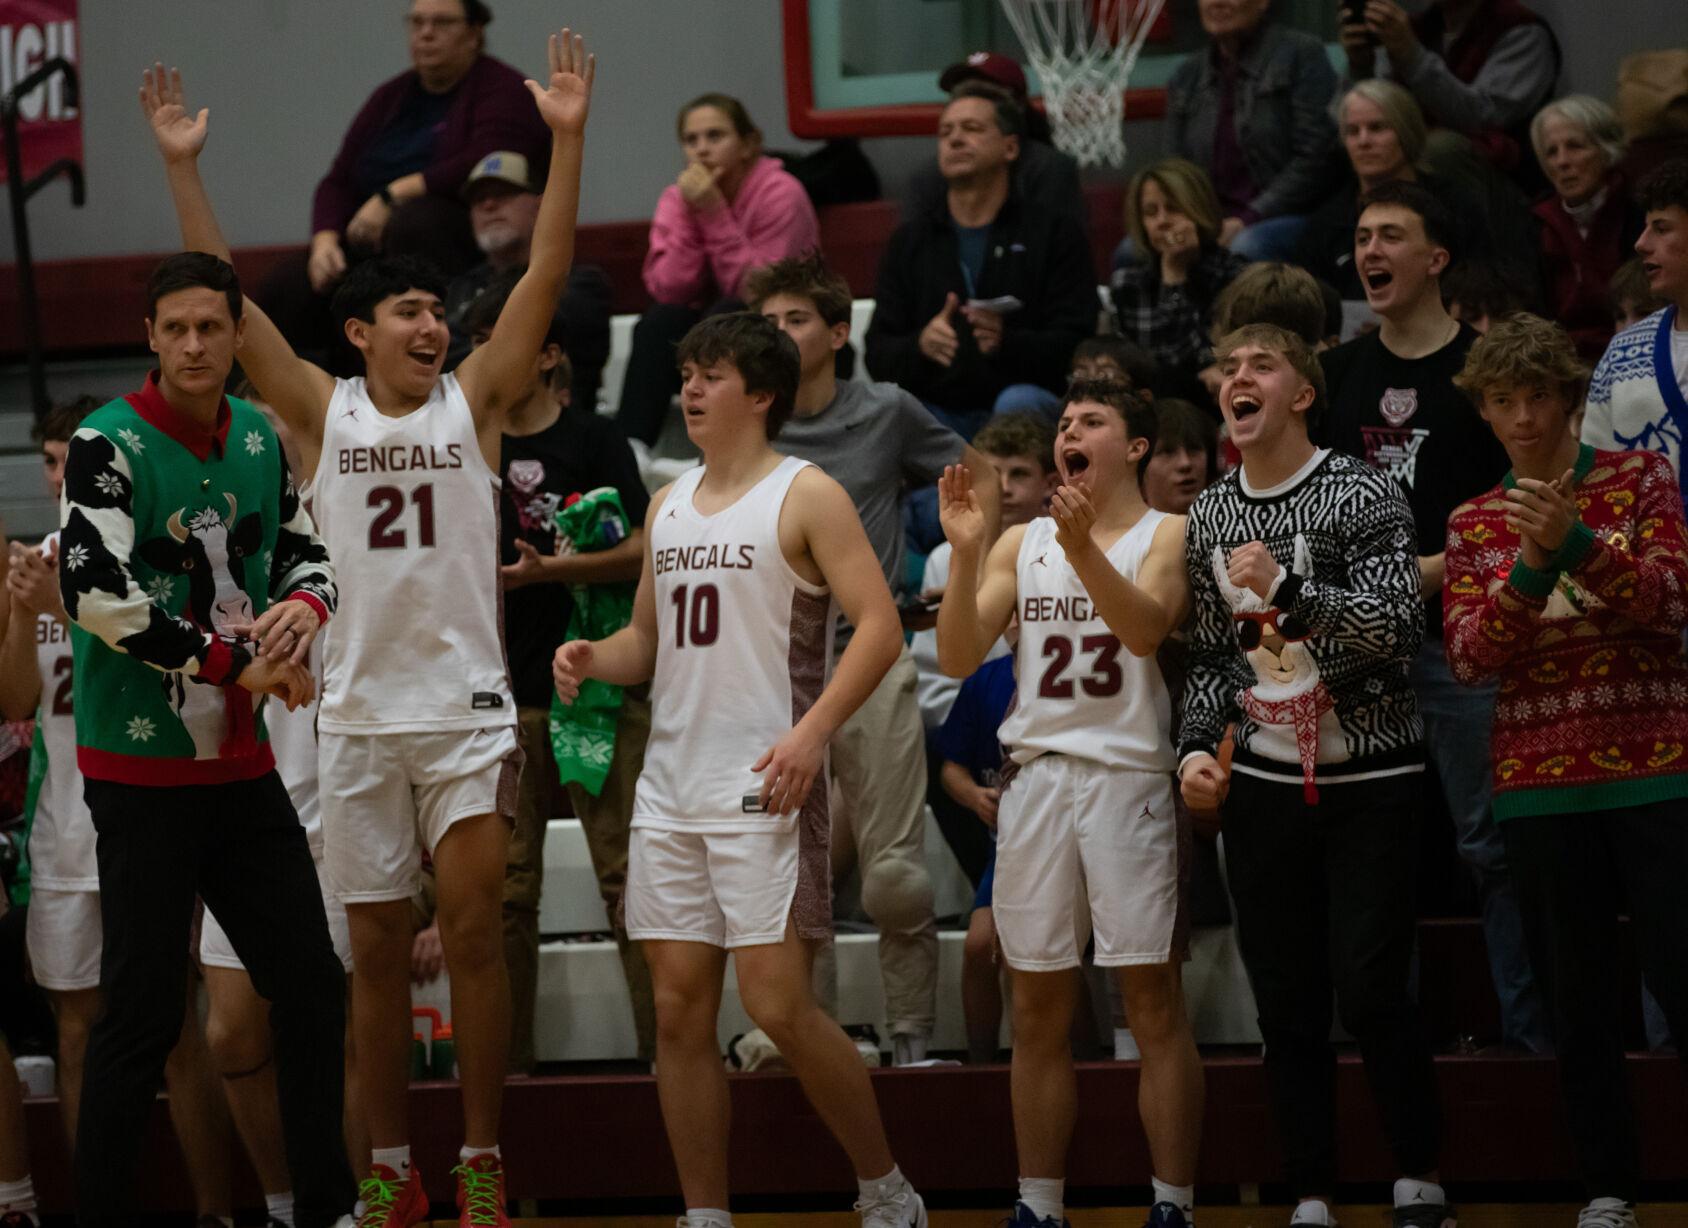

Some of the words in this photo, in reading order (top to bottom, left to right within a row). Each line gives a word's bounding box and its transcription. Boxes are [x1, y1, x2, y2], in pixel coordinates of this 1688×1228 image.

[339, 443, 462, 474] BENGALS
[366, 482, 436, 550] 21
[656, 543, 755, 575] BENGALS
[671, 582, 720, 649] 10
[1024, 596, 1099, 622] BENG
[1037, 632, 1122, 699] 23
